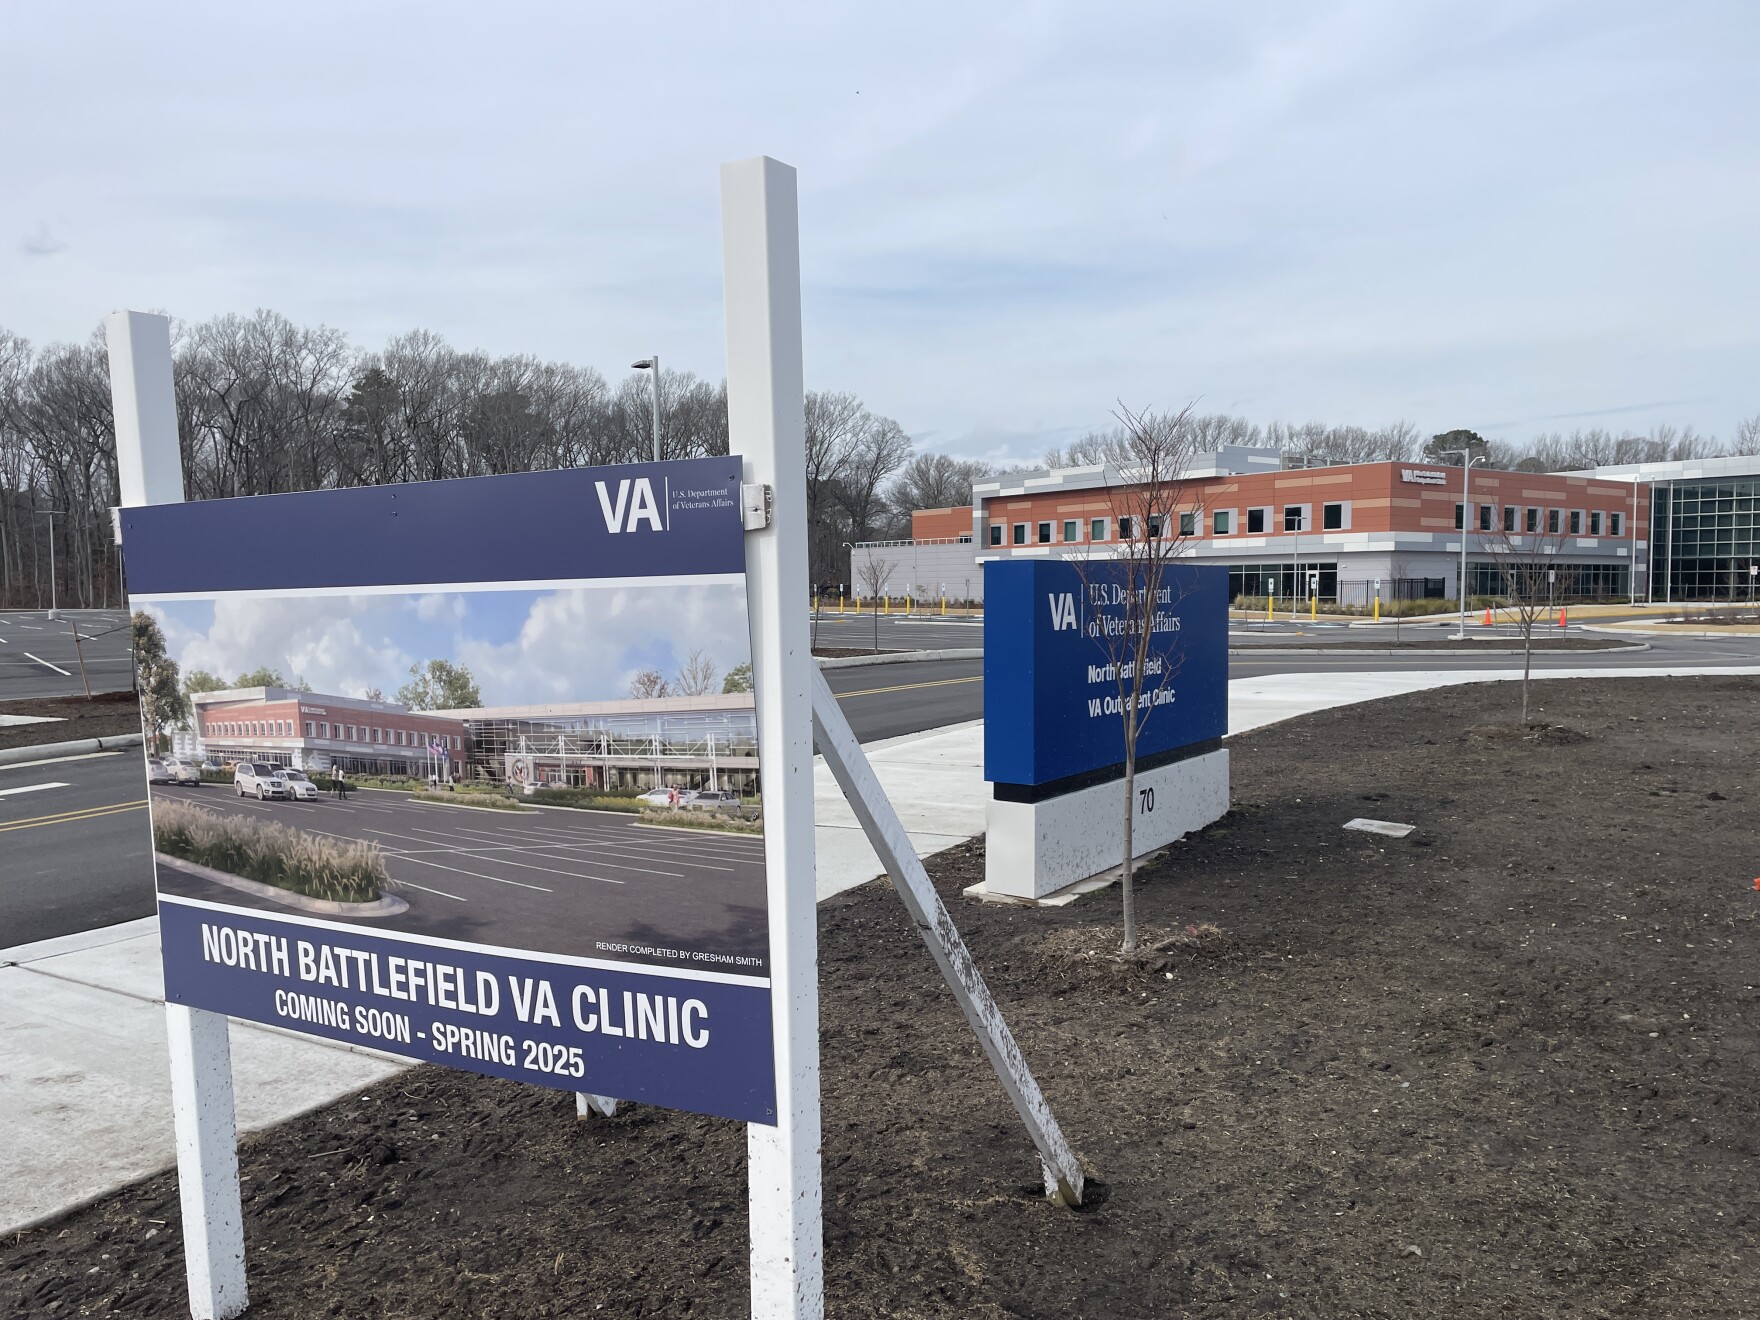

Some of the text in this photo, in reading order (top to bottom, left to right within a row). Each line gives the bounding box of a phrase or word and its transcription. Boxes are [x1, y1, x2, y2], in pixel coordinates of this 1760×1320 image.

[1401, 469, 1413, 482] VA
[594, 477, 663, 533] VA
[672, 488, 728, 498] U.S. Department
[672, 498, 734, 509] of Veterans Affairs
[1089, 583, 1171, 610] U.S. Departent
[1049, 593, 1077, 630] VA
[1088, 614, 1102, 637] of
[1148, 611, 1181, 633] Affairs
[1088, 662, 1116, 684] North
[1088, 686, 1176, 718] VA Outpaent Clinic
[1139, 787, 1154, 814] 70
[596, 941, 763, 967] RENDER COMPLETED BY GRESHAM SMITH
[201, 923, 710, 1049] NORTH BATTLEFIELD VA CLINIC
[275, 989, 350, 1031] COMING
[354, 1005, 411, 1044] SOON
[431, 1021, 516, 1066] SPRING
[522, 1039, 585, 1078] 2025
